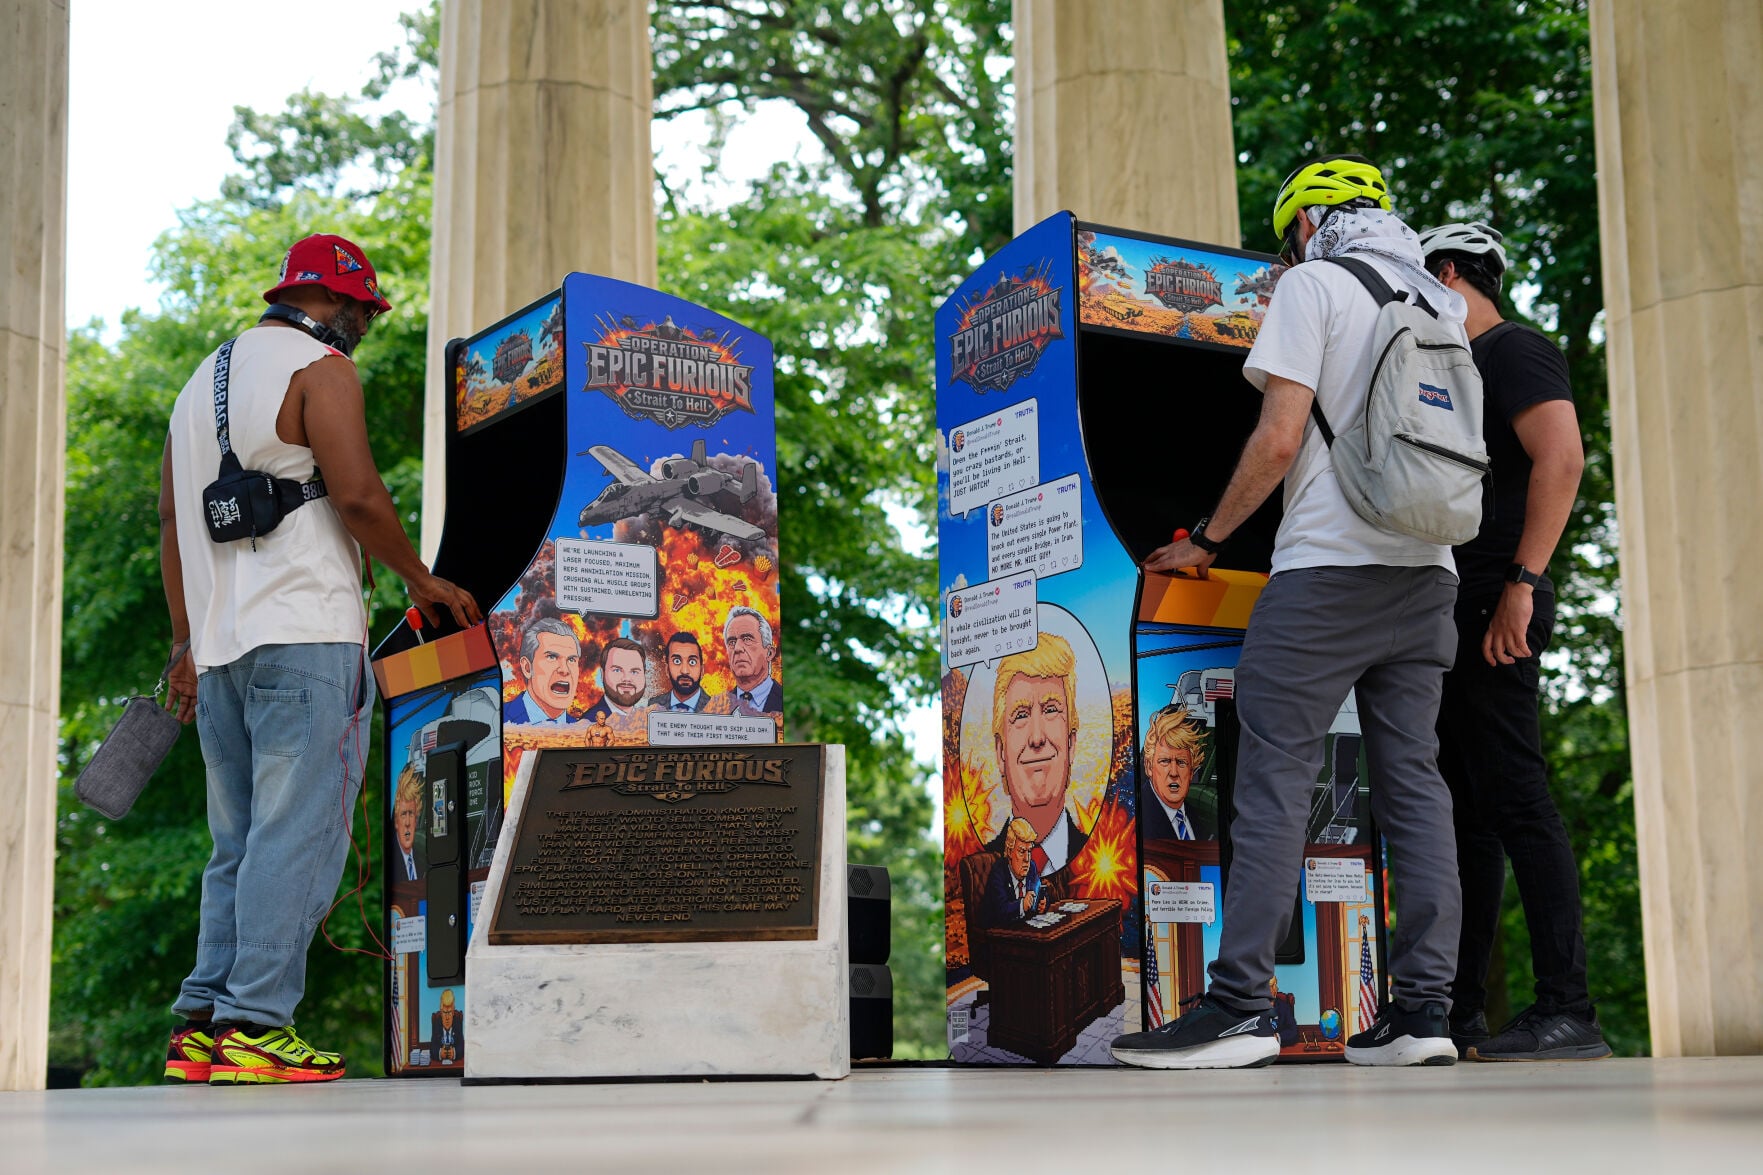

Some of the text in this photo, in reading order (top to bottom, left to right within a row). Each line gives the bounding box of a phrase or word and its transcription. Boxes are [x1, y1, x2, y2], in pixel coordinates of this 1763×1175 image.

[1147, 272, 1220, 301] EPIC FURIOUS
[978, 288, 1030, 323] OPERATION
[953, 291, 1061, 374] EPIC FURIOUS
[631, 338, 709, 361] OPERATION
[981, 345, 1030, 378] Strait To Hell
[589, 345, 750, 402] EPIC FURIOUS
[633, 390, 707, 412] Strait To Hell
[953, 456, 966, 466] Open
[968, 450, 978, 459] the
[953, 469, 963, 477] you
[966, 460, 982, 472] crazy
[953, 475, 970, 488] you'll
[972, 471, 979, 480] be
[982, 466, 1001, 477] living
[1004, 461, 1010, 469] in
[1013, 455, 1026, 466] Hell
[953, 479, 990, 498] JUST WATCH!
[991, 511, 1068, 540] The United States is going to
[991, 542, 1004, 551] knock
[1007, 539, 1015, 547] out
[1016, 535, 1030, 544] every
[1032, 530, 1046, 540] single
[1049, 525, 1061, 534] Power
[583, 549, 616, 557] LAUNCHING
[992, 554, 1000, 563] and
[1002, 550, 1016, 560] every
[1017, 544, 1032, 556] single
[992, 566, 998, 574] NO
[1000, 562, 1012, 571] MORE
[1025, 554, 1036, 565] NICE
[581, 568, 623, 576] ANNIHILATION
[581, 587, 613, 595] SUSTAINED,
[615, 590, 651, 598] UNRELENTING
[956, 622, 971, 632] whole
[973, 614, 1006, 628] civilization
[1008, 609, 1020, 618] will
[1023, 607, 1032, 615] die
[974, 631, 989, 640] never
[992, 628, 998, 636] to
[1000, 626, 1007, 634] be
[1010, 618, 1032, 632] brought
[951, 649, 962, 658] back
[631, 752, 733, 762] OPERATION
[572, 760, 784, 784] EPIC FURIOUS
[628, 782, 725, 791] Strait To Hell
[618, 808, 717, 816] ADMINISTRATION
